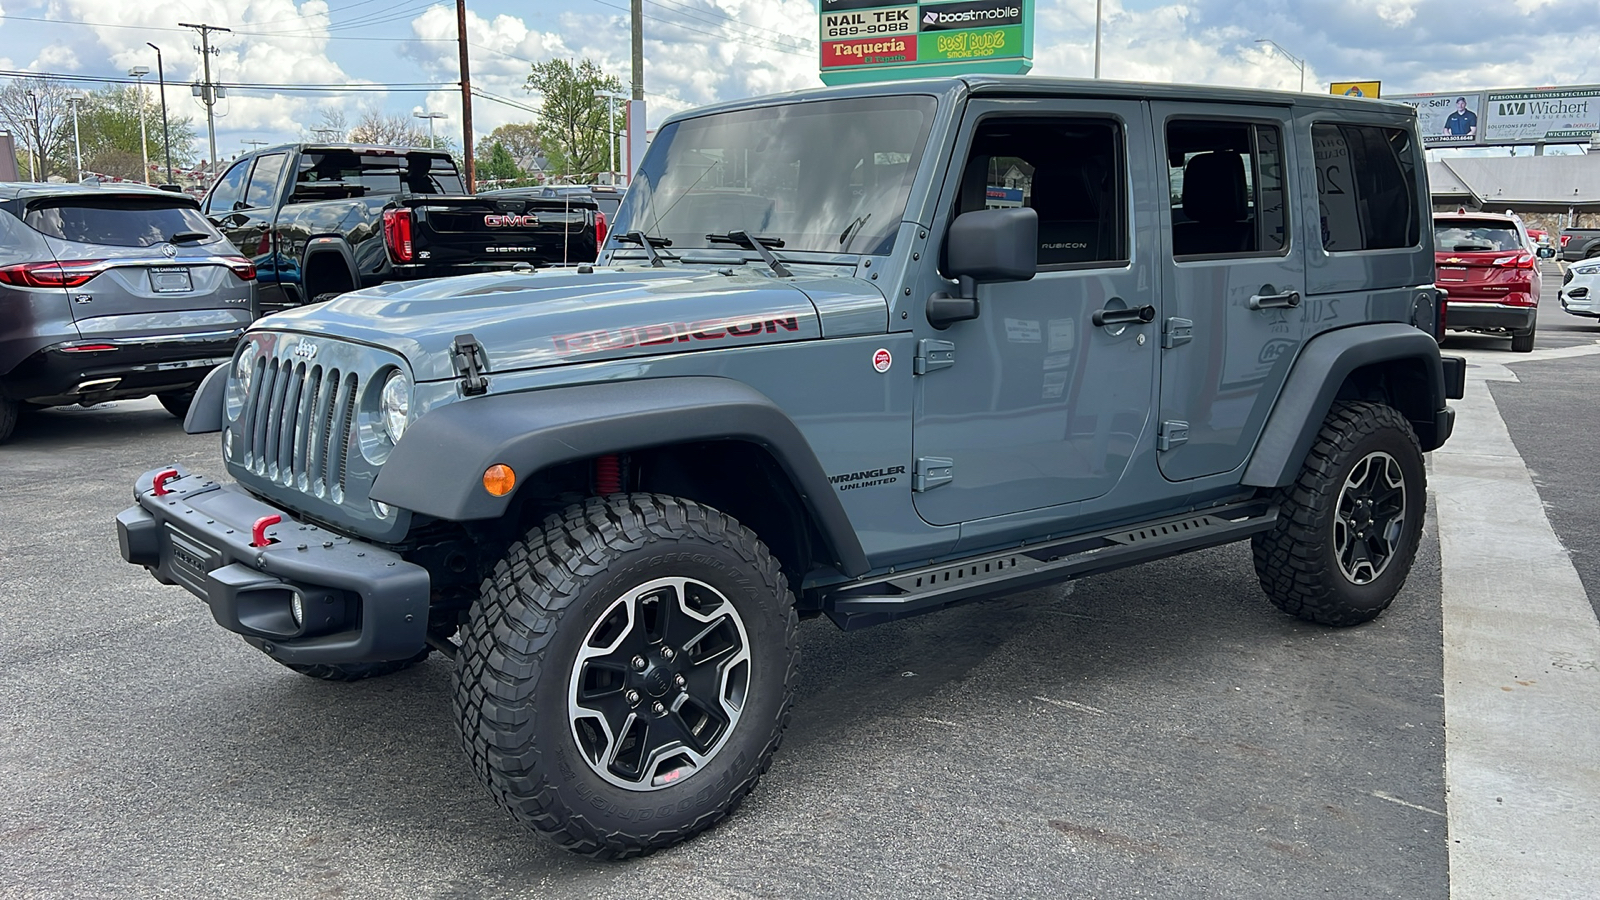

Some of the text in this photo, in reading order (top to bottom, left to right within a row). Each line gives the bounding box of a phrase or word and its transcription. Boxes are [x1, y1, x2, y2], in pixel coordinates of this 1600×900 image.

[827, 10, 909, 26] NAIL TEK
[940, 6, 1019, 22] boostmobile
[829, 22, 908, 36] 689-9088
[969, 30, 1005, 50] BUDZ
[947, 48, 994, 58] SMOKE SHOP
[1430, 100, 1450, 108] Sell?
[1529, 100, 1588, 114] Wichert
[484, 214, 540, 226] GMC
[553, 312, 800, 354] RUBICON
[294, 337, 318, 361] Jeep
[828, 466, 906, 484] WRANGLER
[840, 477, 896, 491] UNLIMITED
